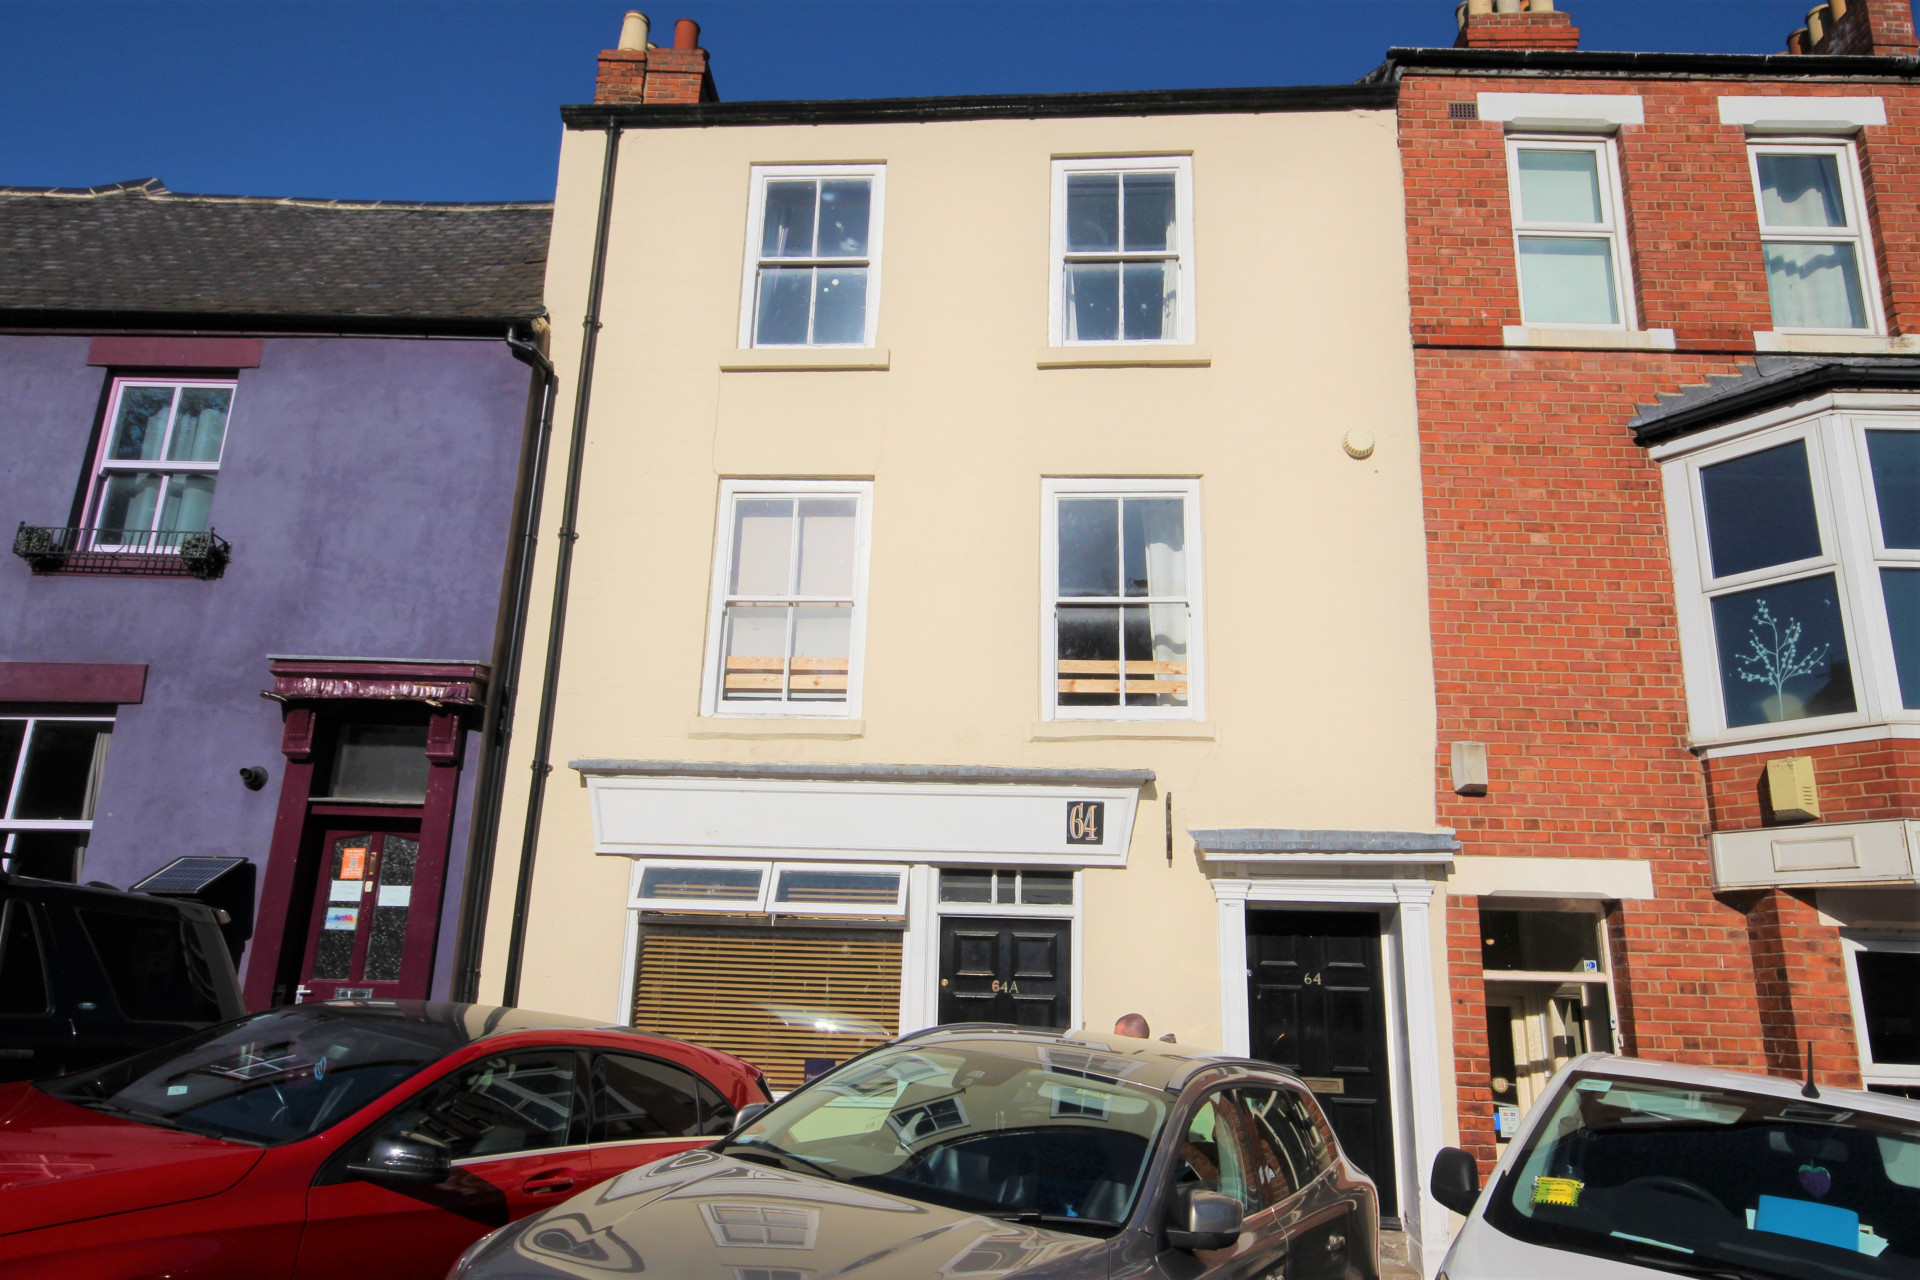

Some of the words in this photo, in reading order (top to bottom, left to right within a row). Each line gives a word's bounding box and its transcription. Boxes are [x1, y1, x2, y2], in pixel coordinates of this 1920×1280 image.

[1070, 802, 1098, 840] 64
[1304, 972, 1321, 985] 64
[991, 980, 1019, 993] 64A
